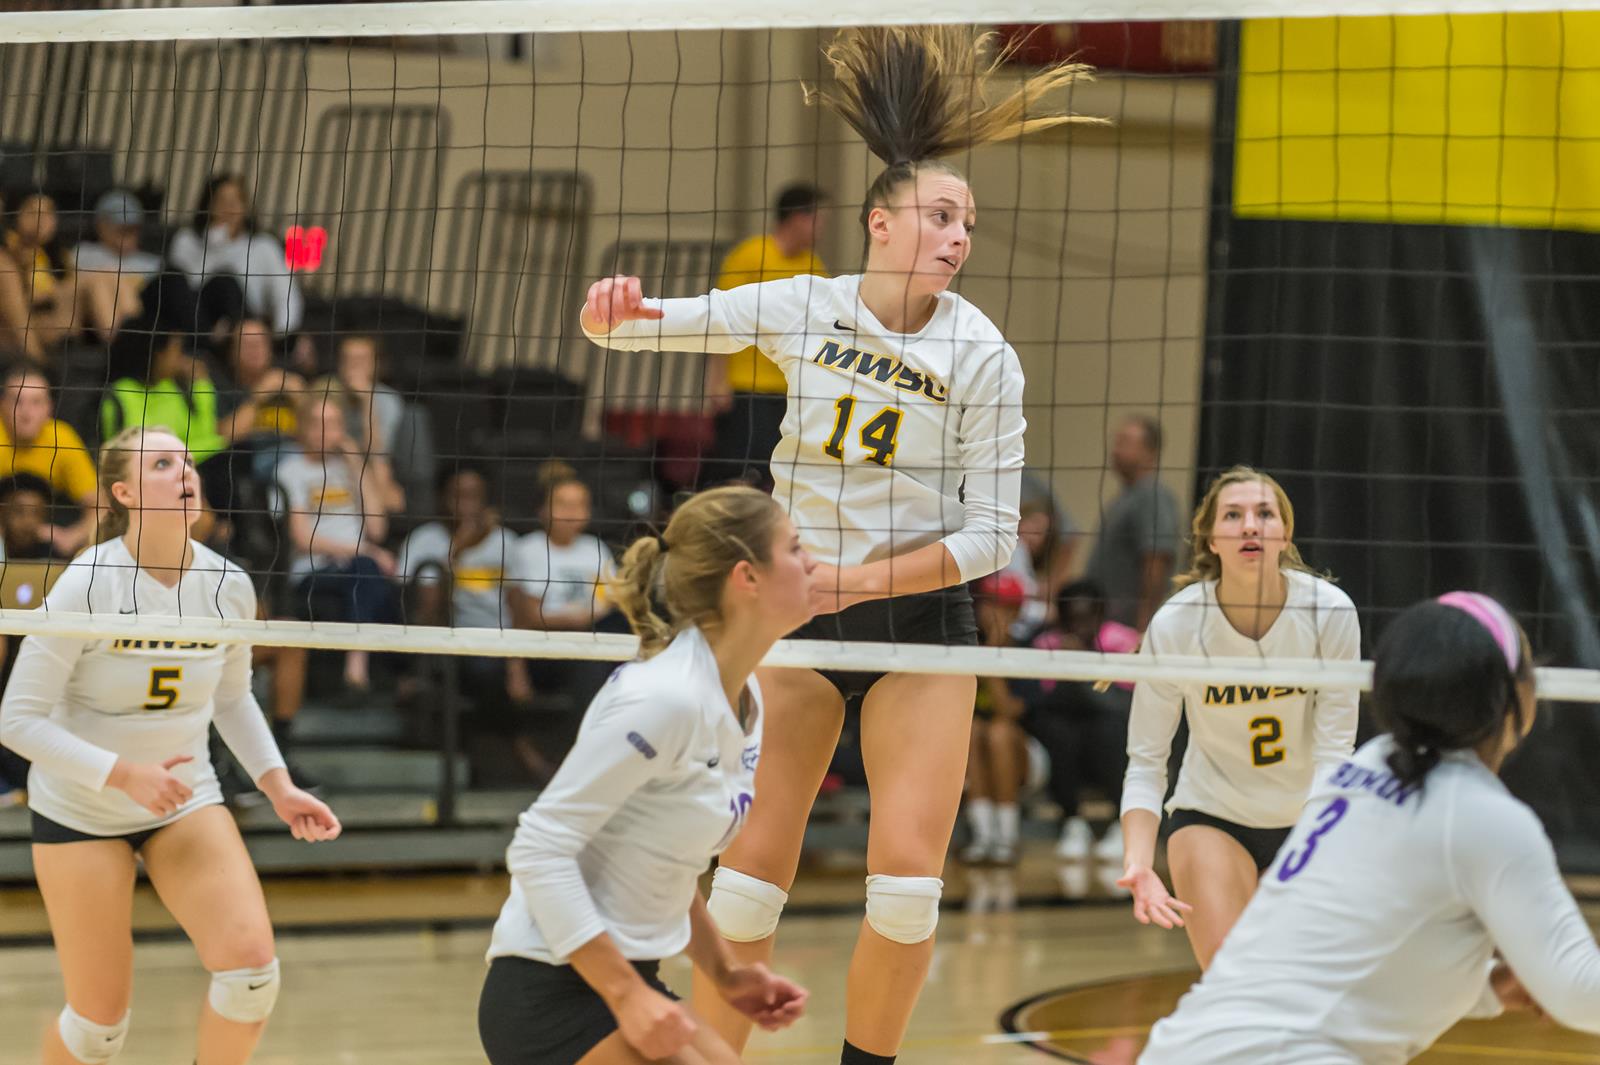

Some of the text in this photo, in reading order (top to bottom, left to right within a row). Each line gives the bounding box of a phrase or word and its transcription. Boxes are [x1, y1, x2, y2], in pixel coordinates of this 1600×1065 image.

[822, 394, 904, 467] 14
[142, 666, 183, 711] 5
[1249, 715, 1286, 768] 2
[1277, 796, 1349, 882] 3
